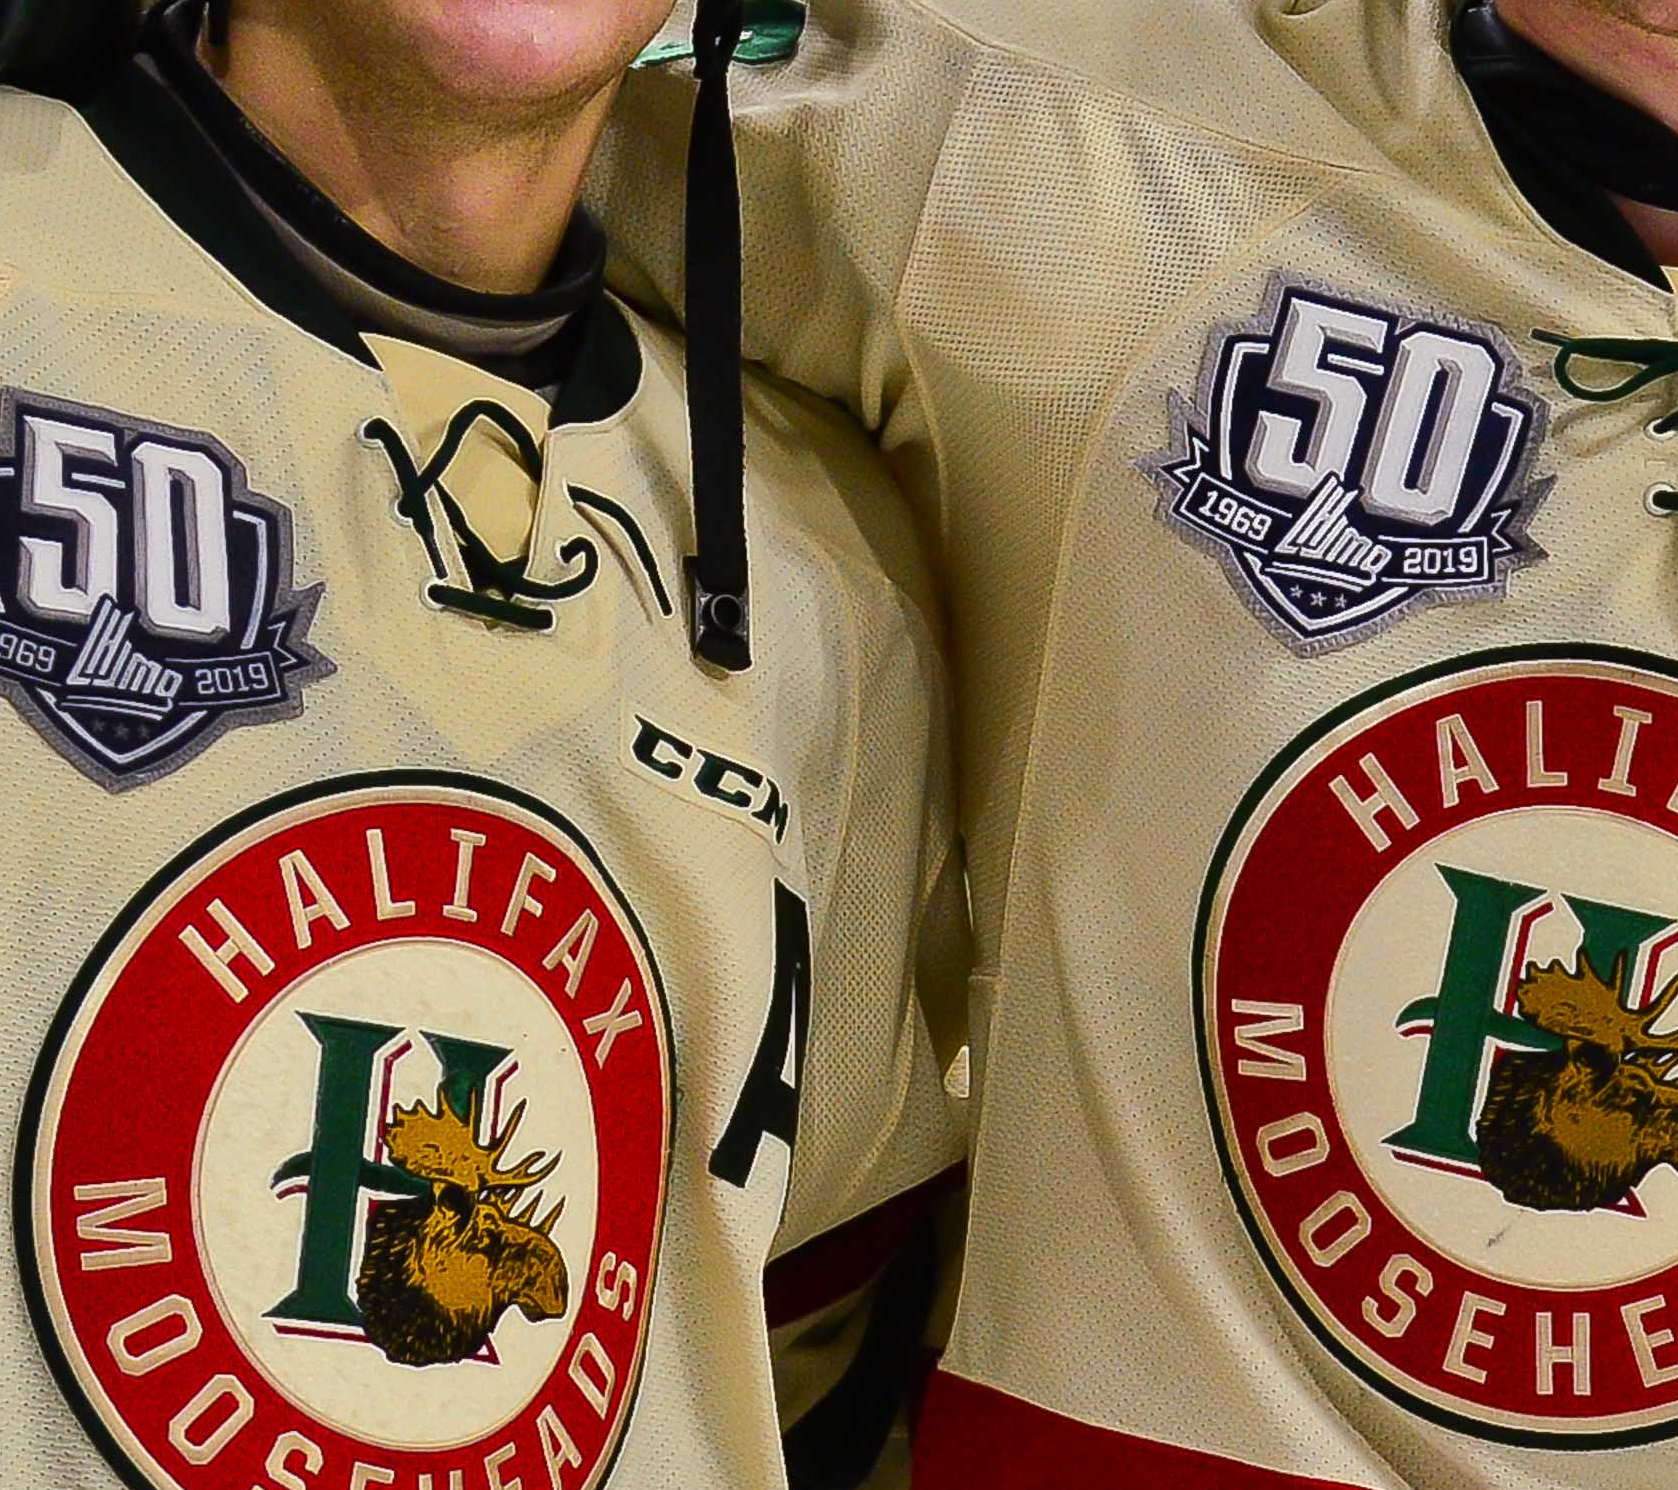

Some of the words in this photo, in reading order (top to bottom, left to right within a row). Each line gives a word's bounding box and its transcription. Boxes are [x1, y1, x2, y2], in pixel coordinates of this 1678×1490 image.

[1248, 295, 1497, 523] 50
[17, 413, 231, 637] 50
[1198, 488, 1271, 541] 1969
[1401, 543, 1480, 577] 2019
[194, 664, 268, 695] 2019
[631, 713, 788, 844] CCM
[177, 827, 644, 1071] HALIFAX
[708, 877, 812, 1189] A
